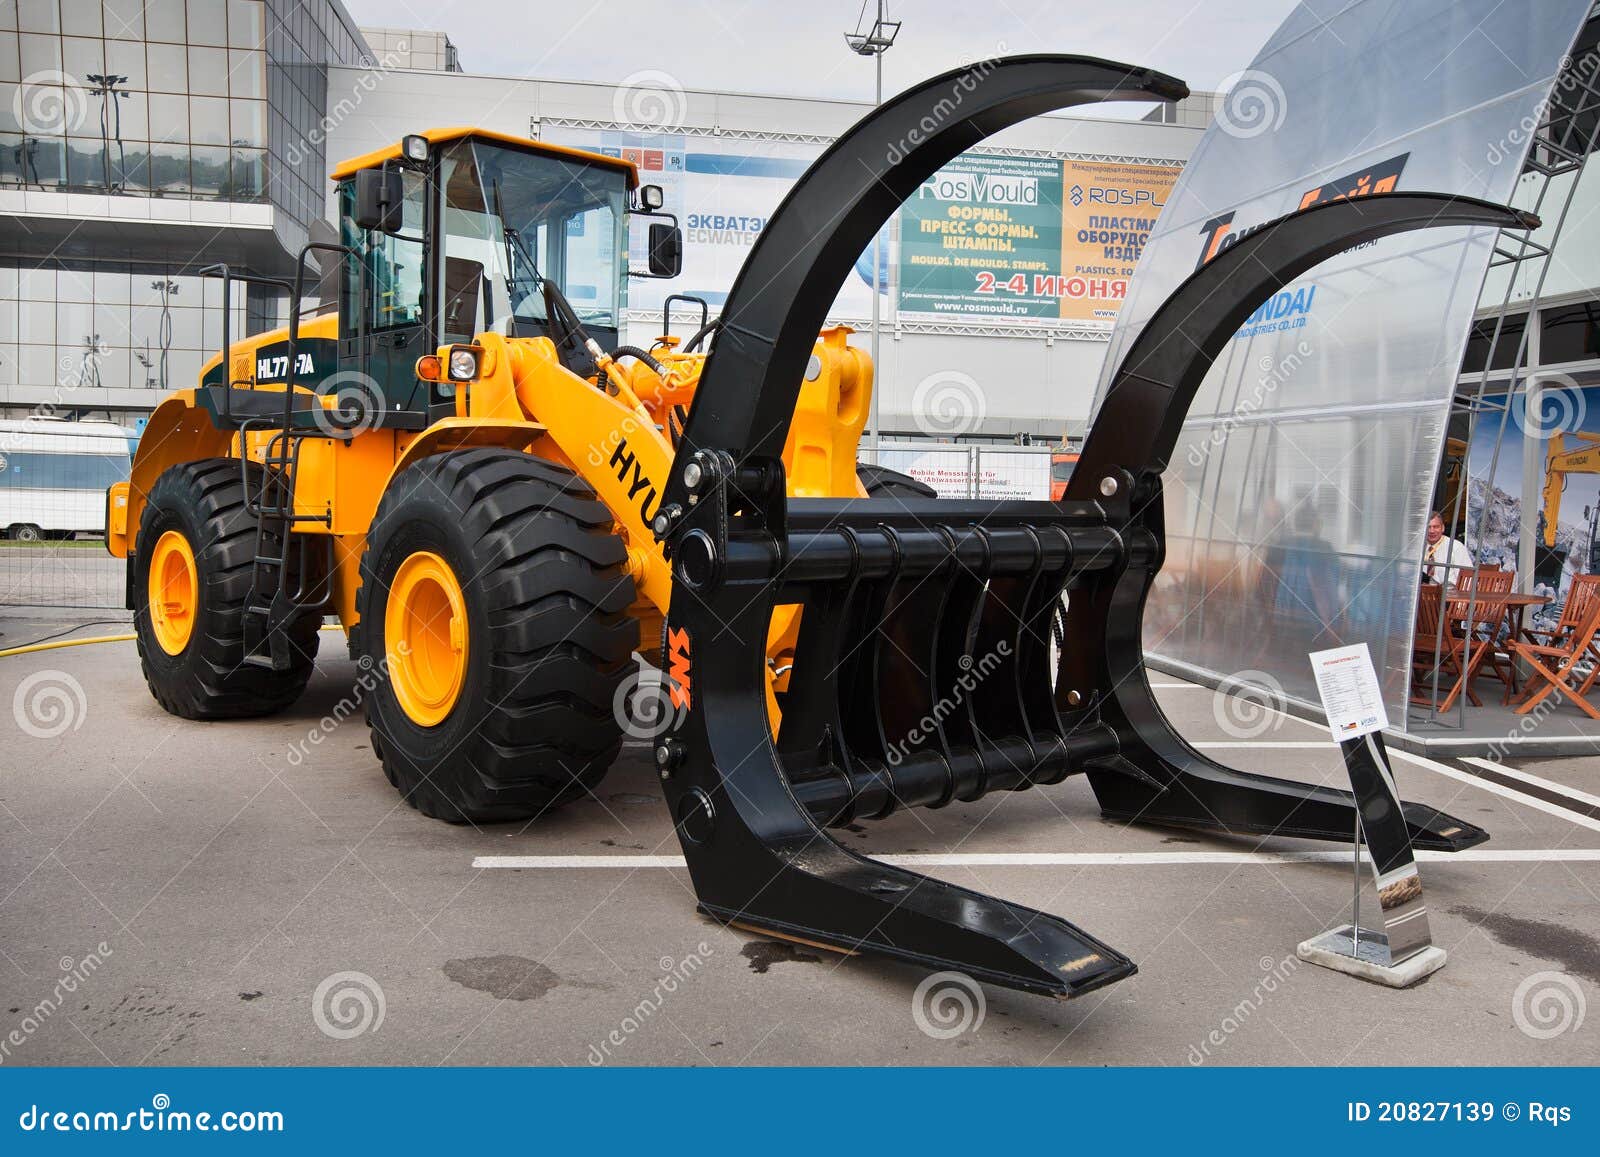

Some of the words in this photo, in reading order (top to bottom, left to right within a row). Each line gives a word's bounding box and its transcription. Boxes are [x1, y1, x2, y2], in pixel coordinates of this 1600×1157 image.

[1029, 160, 1059, 169] выставка
[1071, 163, 1121, 174] Международная
[1094, 175, 1131, 183] International
[919, 172, 1038, 205] RosMould
[947, 205, 1012, 222] ФОРМЫ.
[686, 228, 760, 246] ECWATE
[974, 221, 1039, 239] ФОРМЫ.
[943, 235, 1017, 252] ШТАМПЫ.
[911, 255, 953, 266] MOULDS.
[954, 257, 970, 267] DIE
[970, 258, 1011, 269] MOULDS.
[1012, 260, 1049, 271] STAMPS.
[975, 271, 1028, 297] 2-4
[1033, 275, 1128, 300] ИЮНЯ
[933, 303, 1028, 315] www.rosmould.ru
[257, 353, 315, 379] HL77-7A
